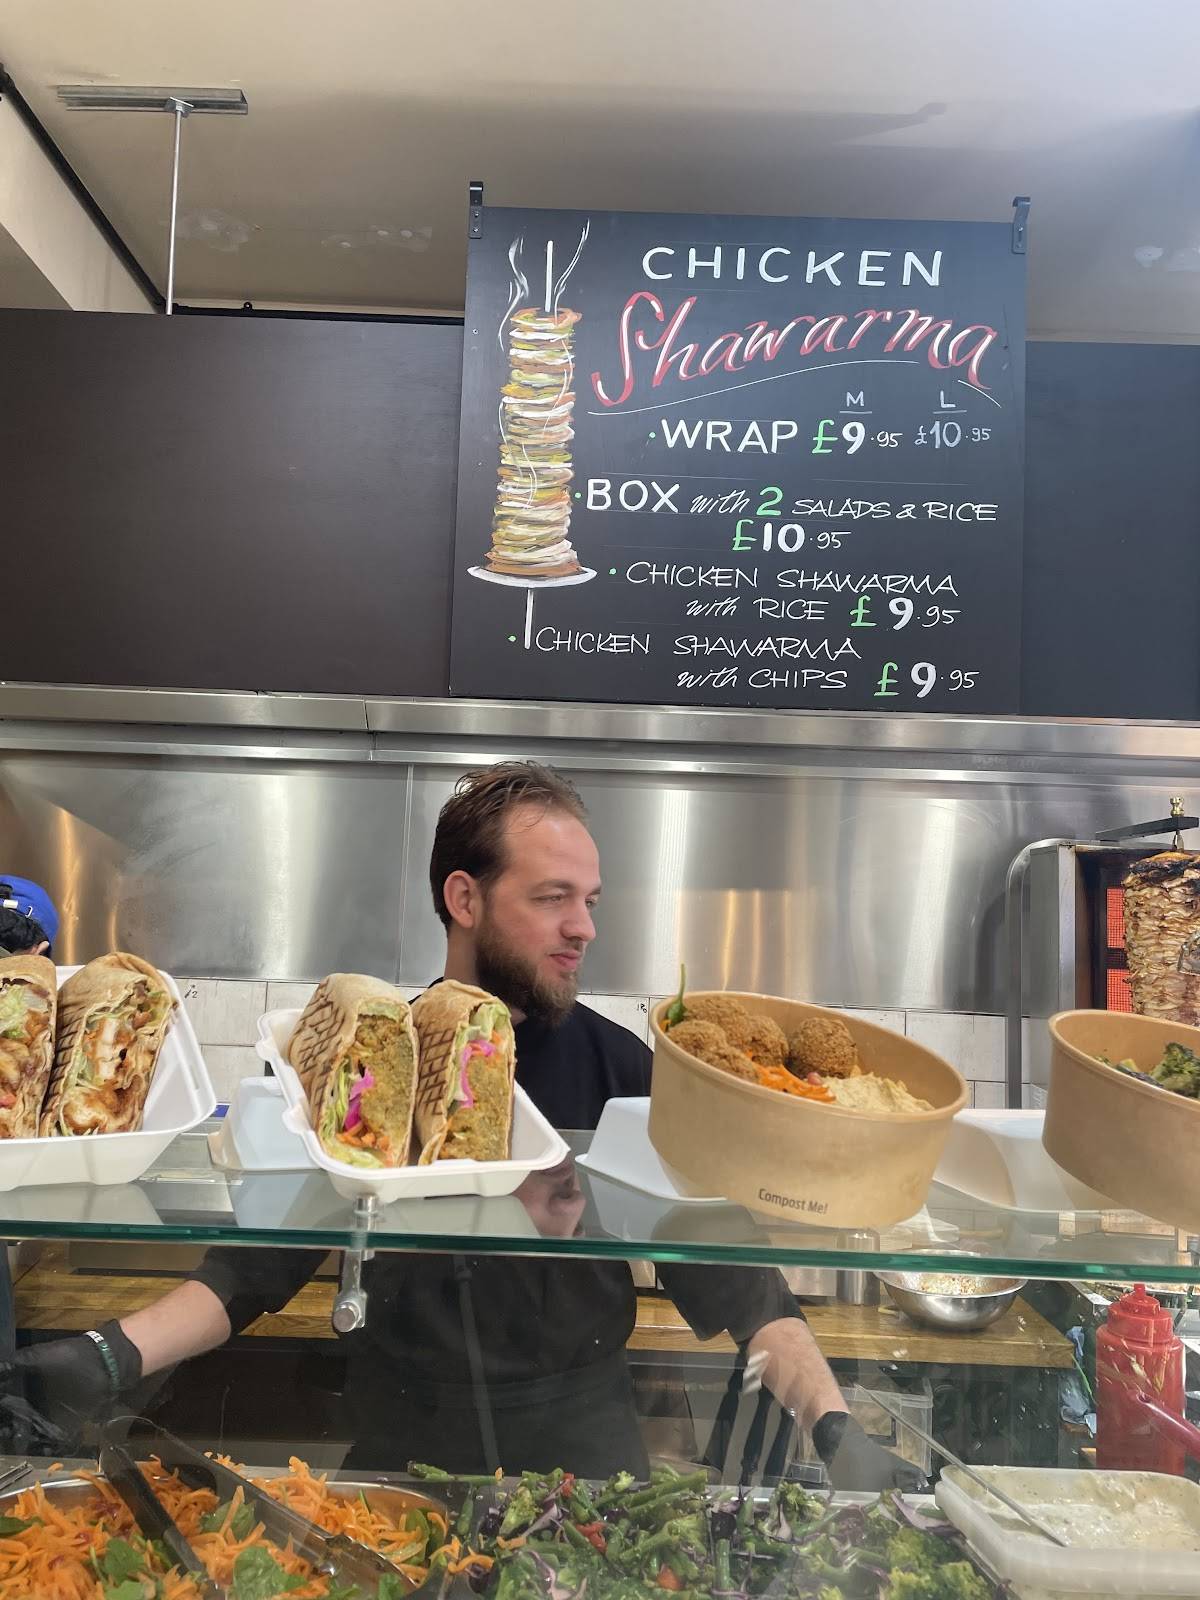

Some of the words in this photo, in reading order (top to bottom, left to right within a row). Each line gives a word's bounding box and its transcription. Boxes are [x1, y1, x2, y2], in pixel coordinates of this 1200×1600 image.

[642, 246, 943, 287] CHICKEN
[591, 291, 999, 407] Shawarma
[846, 391, 865, 407] M
[939, 390, 956, 409] L
[661, 418, 798, 454] WRAP
[586, 478, 680, 513] BOX
[689, 489, 751, 514] with
[756, 486, 784, 516] 2
[791, 498, 891, 520] SALADS
[922, 502, 999, 522] RICE
[626, 561, 758, 588] CHICKEN
[776, 569, 959, 596] SHAWARMA
[686, 596, 741, 618] with
[753, 598, 829, 620] RICE
[535, 626, 650, 654] CHICKEN
[673, 635, 862, 661] SHAWARMA
[676, 667, 739, 689] with
[748, 669, 848, 690] CHIPS
[758, 1188, 807, 1211] Compost
[807, 1200, 828, 1215] Me!
